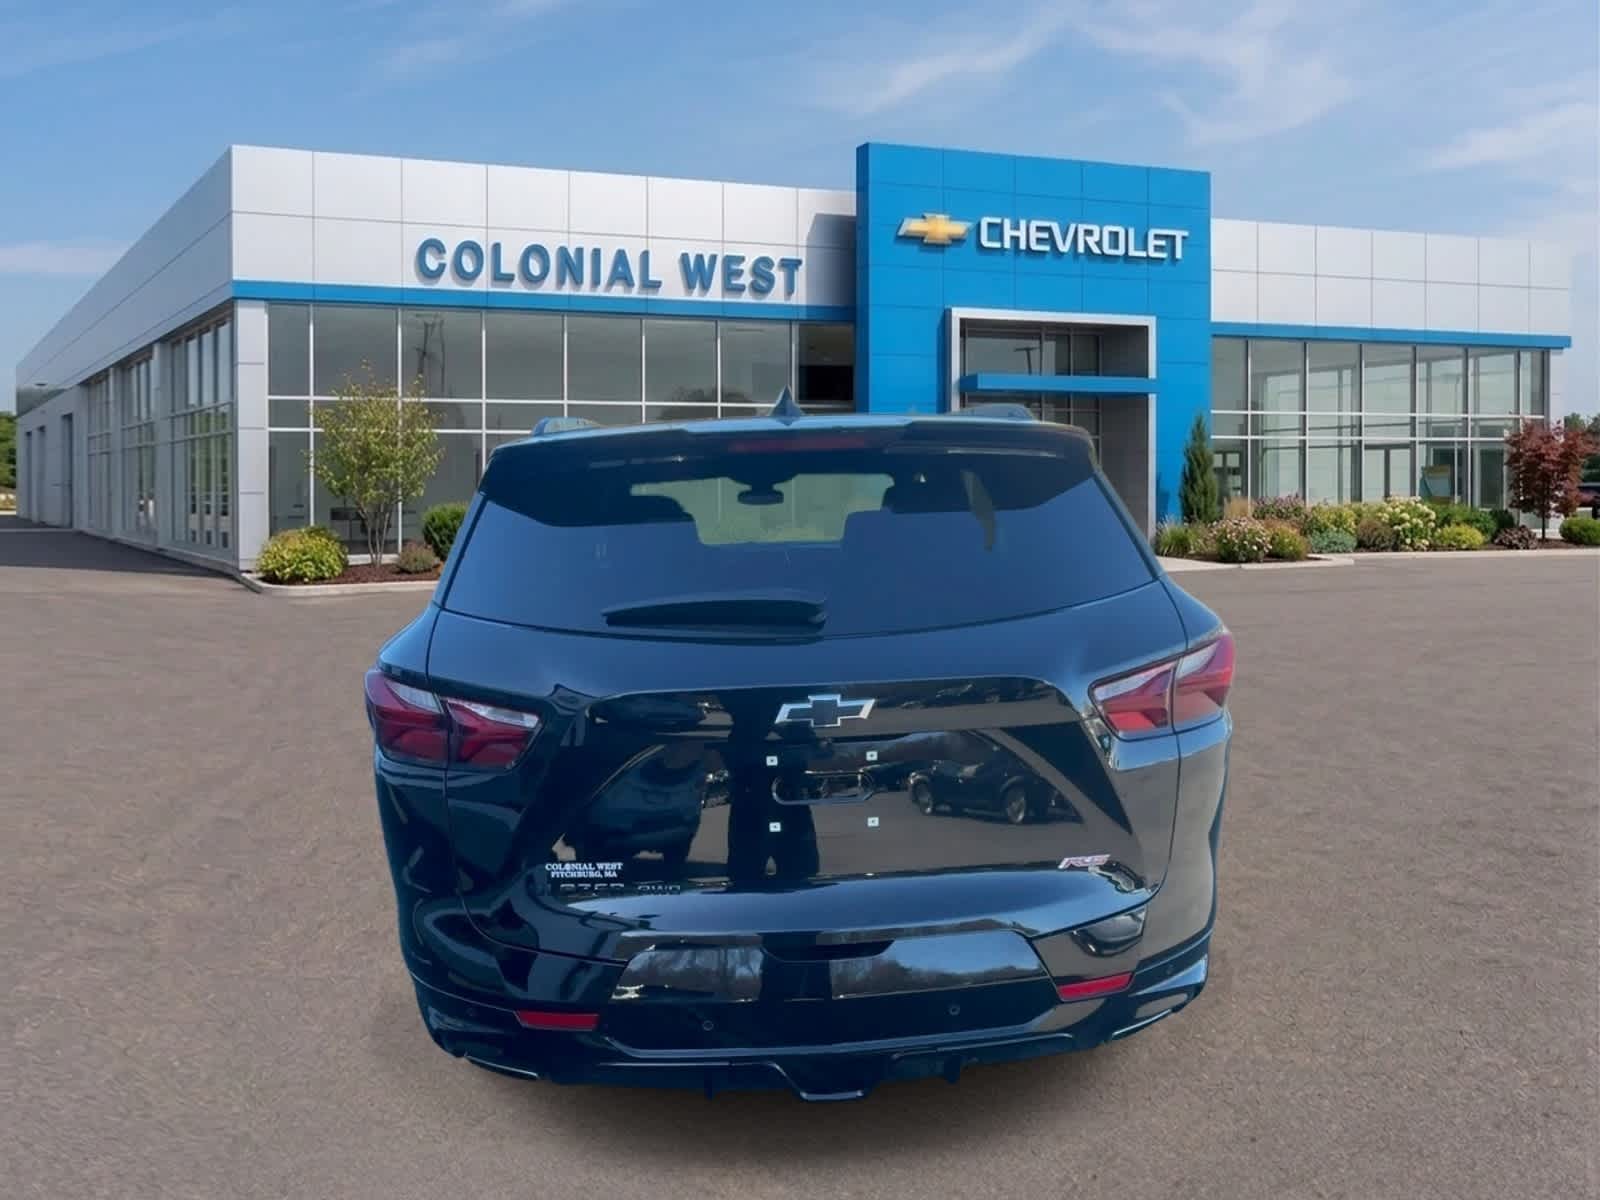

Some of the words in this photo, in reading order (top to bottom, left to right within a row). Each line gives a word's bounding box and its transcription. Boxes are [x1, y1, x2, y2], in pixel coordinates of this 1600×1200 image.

[979, 216, 1190, 260] CHEVROLET
[416, 237, 663, 291] COLONIAL
[680, 251, 803, 296] WEST
[545, 862, 596, 871] COLONIAL
[596, 862, 624, 871] WEST
